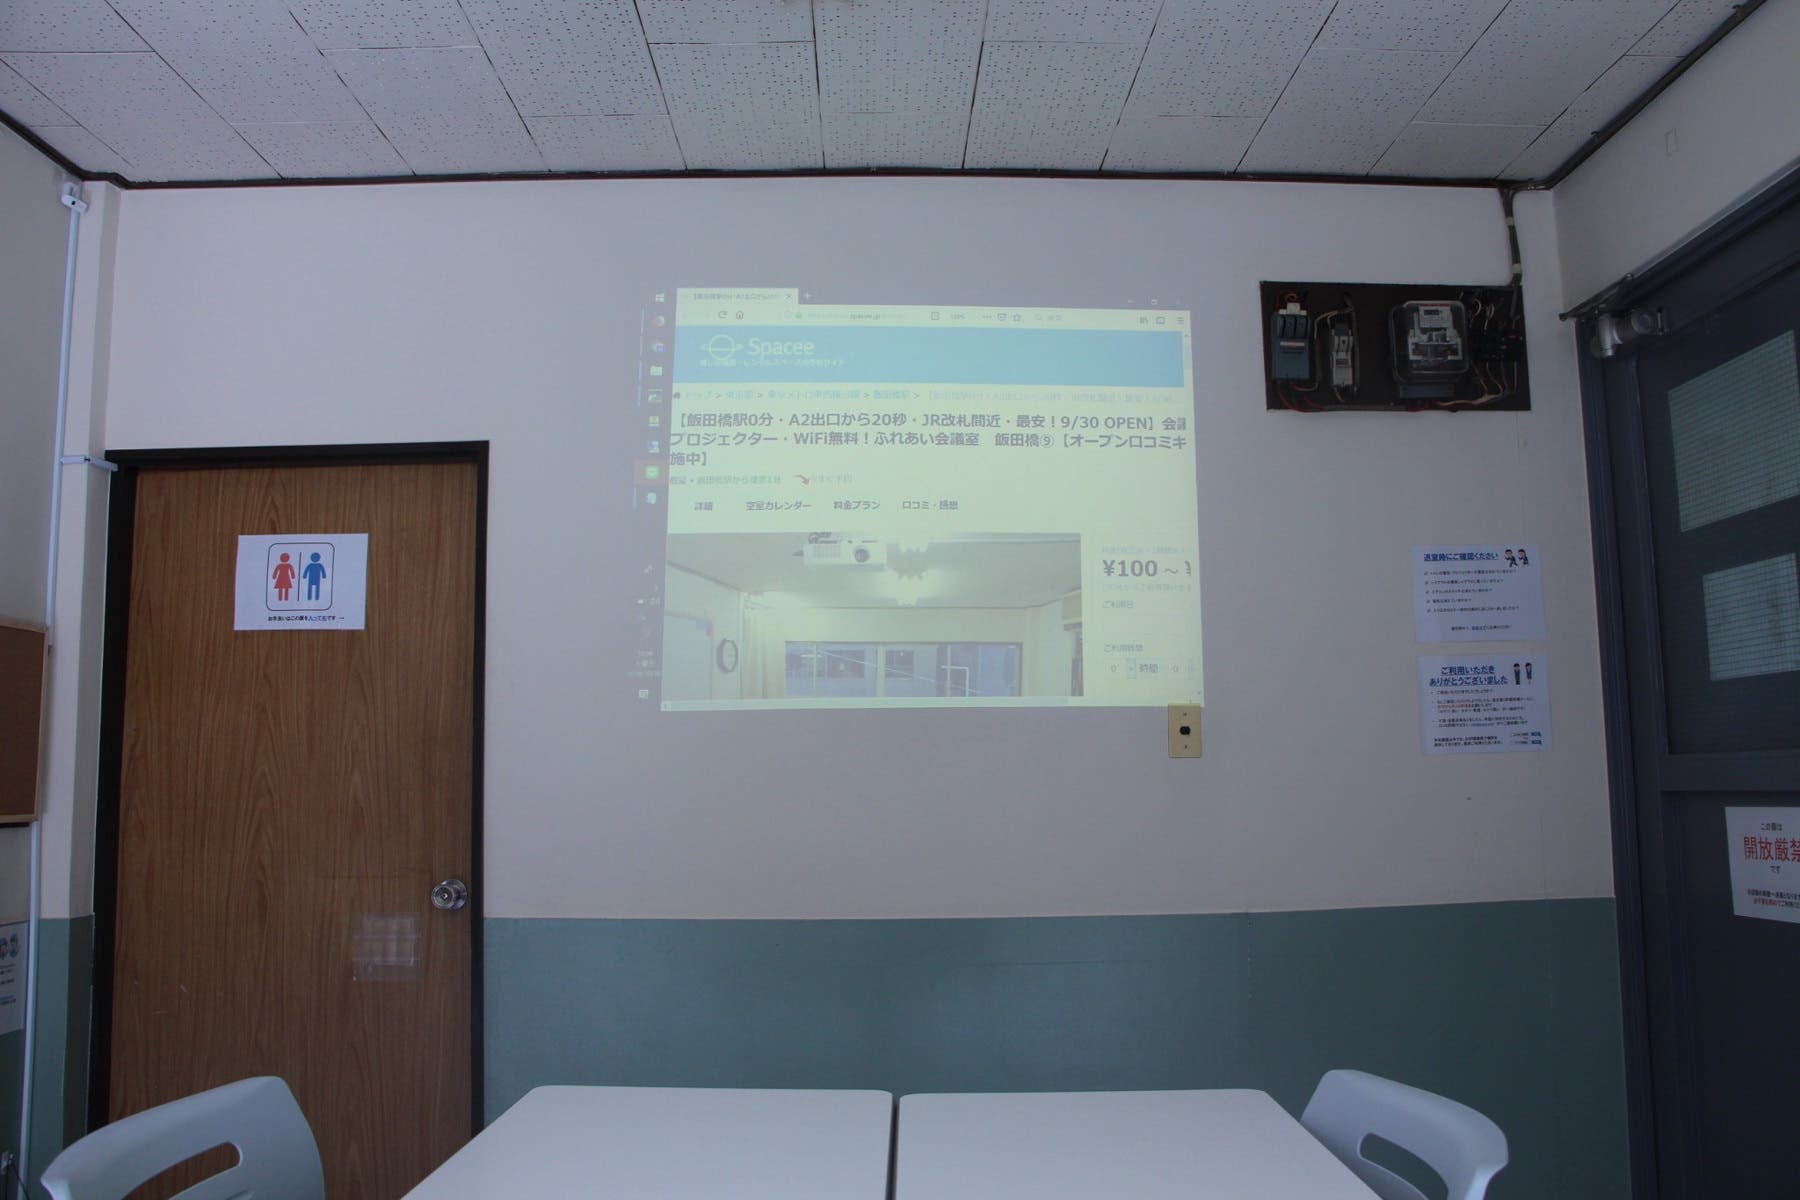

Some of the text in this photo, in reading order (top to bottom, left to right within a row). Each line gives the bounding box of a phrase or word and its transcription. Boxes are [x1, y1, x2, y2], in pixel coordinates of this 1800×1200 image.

[748, 337, 815, 360] Spacee
[746, 501, 812, 511] 空室カレンダー
[833, 500, 881, 511] 料金プラン
[1423, 552, 1498, 562] 退室時にご確認ください
[1102, 559, 1159, 577] ¥100
[1441, 665, 1495, 675] ご利用いただき
[1429, 676, 1508, 687] ありがとうございました
[1743, 836, 1800, 862] 開放厳禁
